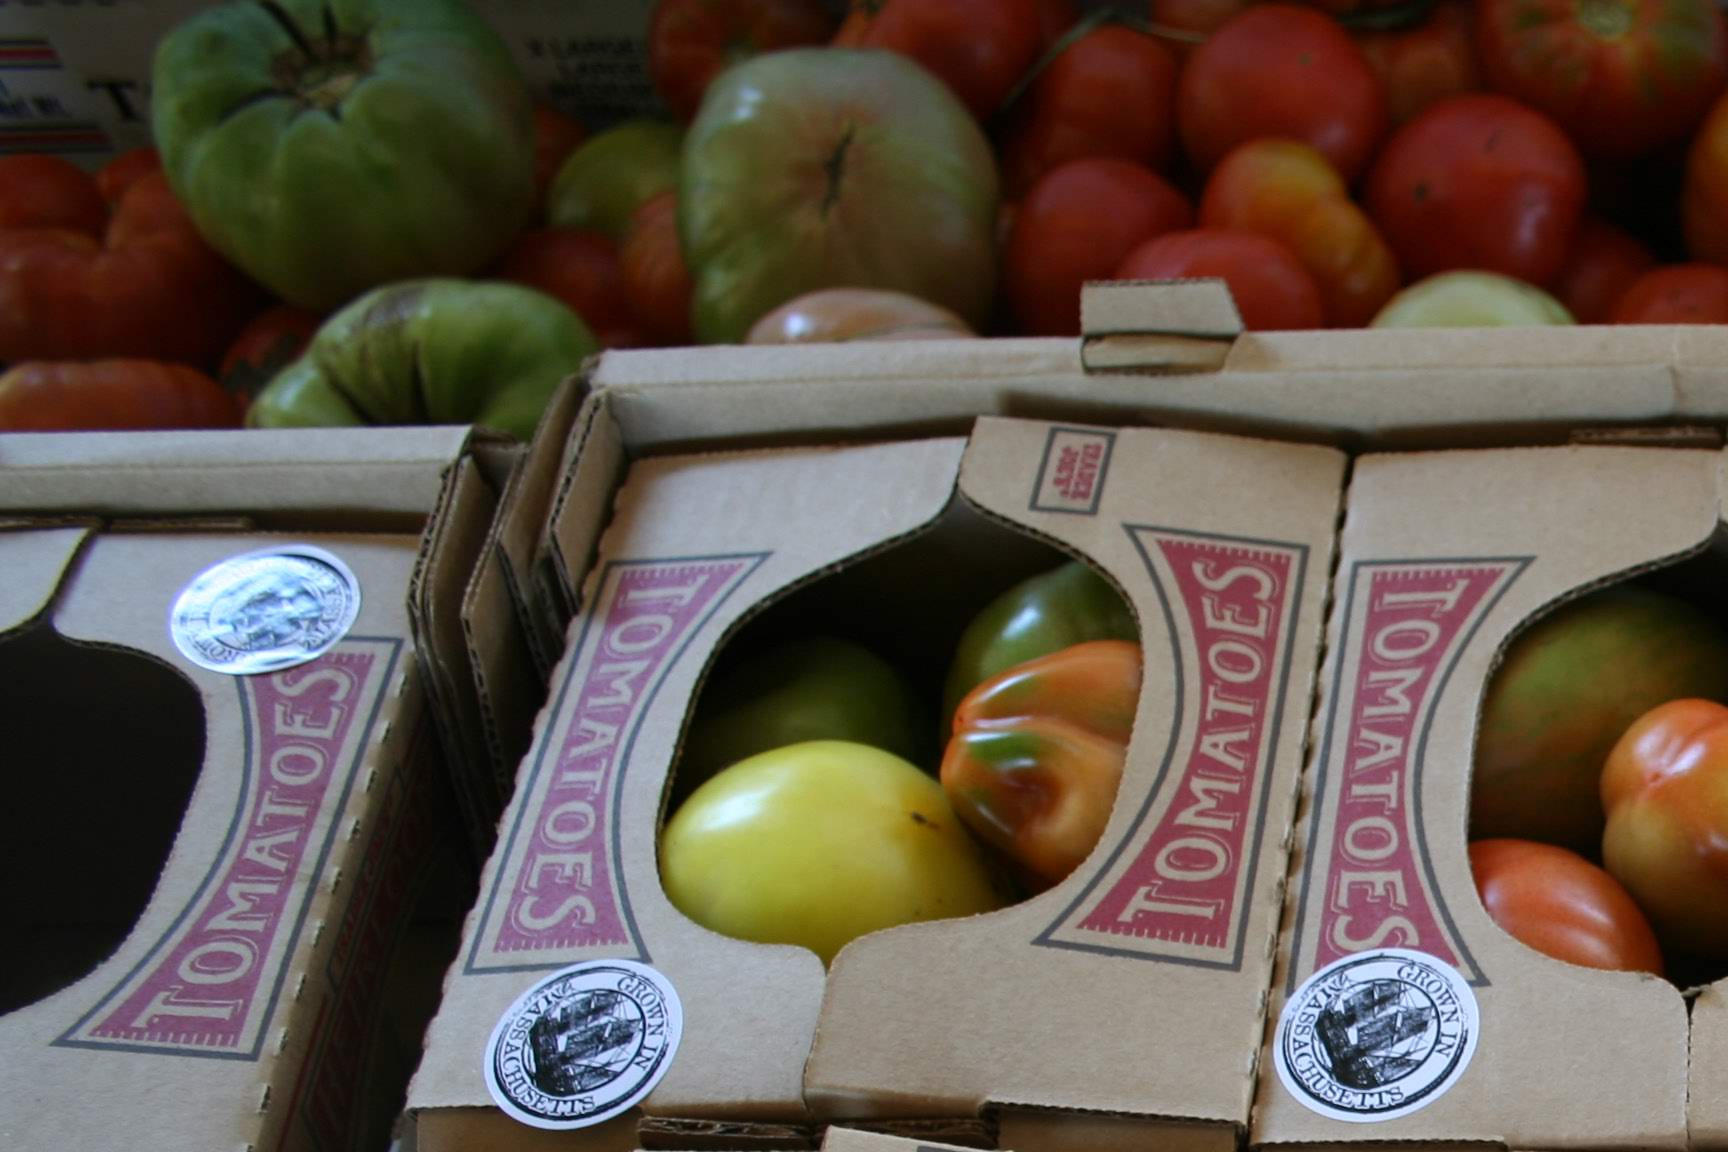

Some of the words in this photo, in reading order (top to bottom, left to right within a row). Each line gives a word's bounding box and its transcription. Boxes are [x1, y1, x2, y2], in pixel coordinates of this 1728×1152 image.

[509, 572, 709, 934] TOMATOES
[1117, 559, 1281, 926] TOMATOES
[1332, 577, 1468, 953] TOMATOES
[132, 667, 358, 1030] TOMATOES
[503, 979, 596, 1115] MASSACHUSETTS
[617, 976, 666, 1037] GROWN
[633, 1044, 658, 1071] IN
[1293, 971, 1404, 1109] MASSACHUSETTS
[1397, 964, 1460, 1025] GROWN
[1435, 1031, 1458, 1058] IN
